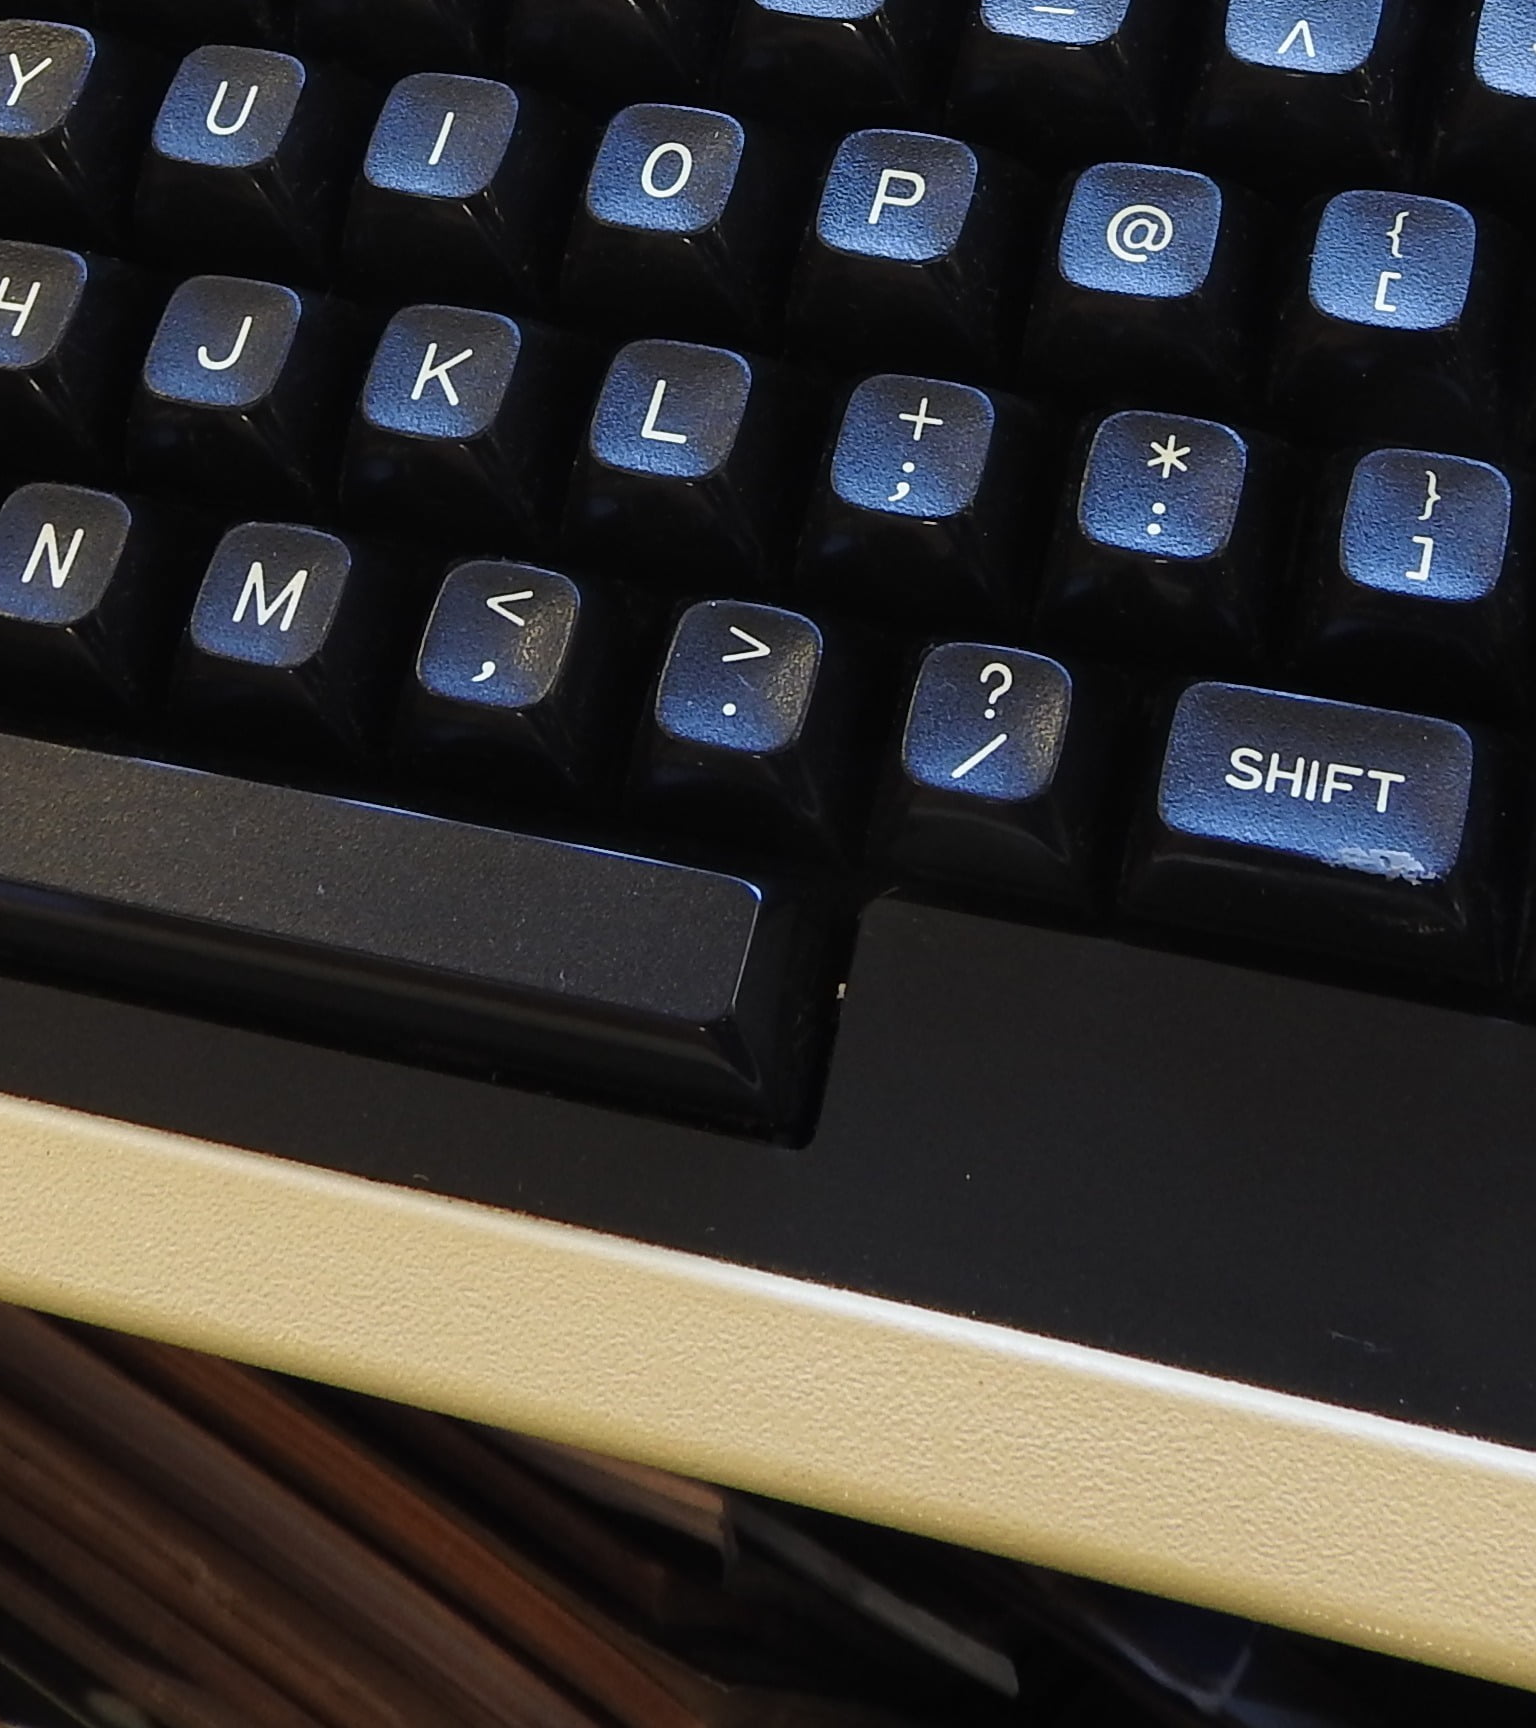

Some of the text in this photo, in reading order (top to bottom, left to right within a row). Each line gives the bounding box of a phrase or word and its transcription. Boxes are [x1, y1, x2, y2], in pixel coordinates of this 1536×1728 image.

[7, 54, 52, 106] Y
[207, 81, 258, 135] U
[429, 112, 454, 165] I
[642, 143, 692, 197] O
[869, 169, 925, 224] P
[1107, 205, 1172, 262] @
[1386, 212, 1409, 258] {
[1375, 272, 1401, 312] [
[198, 317, 252, 370] J
[411, 343, 472, 405] K
[642, 380, 687, 443] L
[899, 398, 943, 440] +
[888, 462, 914, 501] ;
[1418, 471, 1440, 520] }
[1147, 503, 1165, 537] :
[22, 524, 83, 588] N
[1406, 536, 1433, 581] ]
[233, 562, 307, 631] M
[487, 591, 533, 626] <
[722, 627, 770, 661] >
[981, 663, 1012, 719] ?
[952, 734, 1006, 778] /
[1226, 748, 1405, 812] SHIFT
